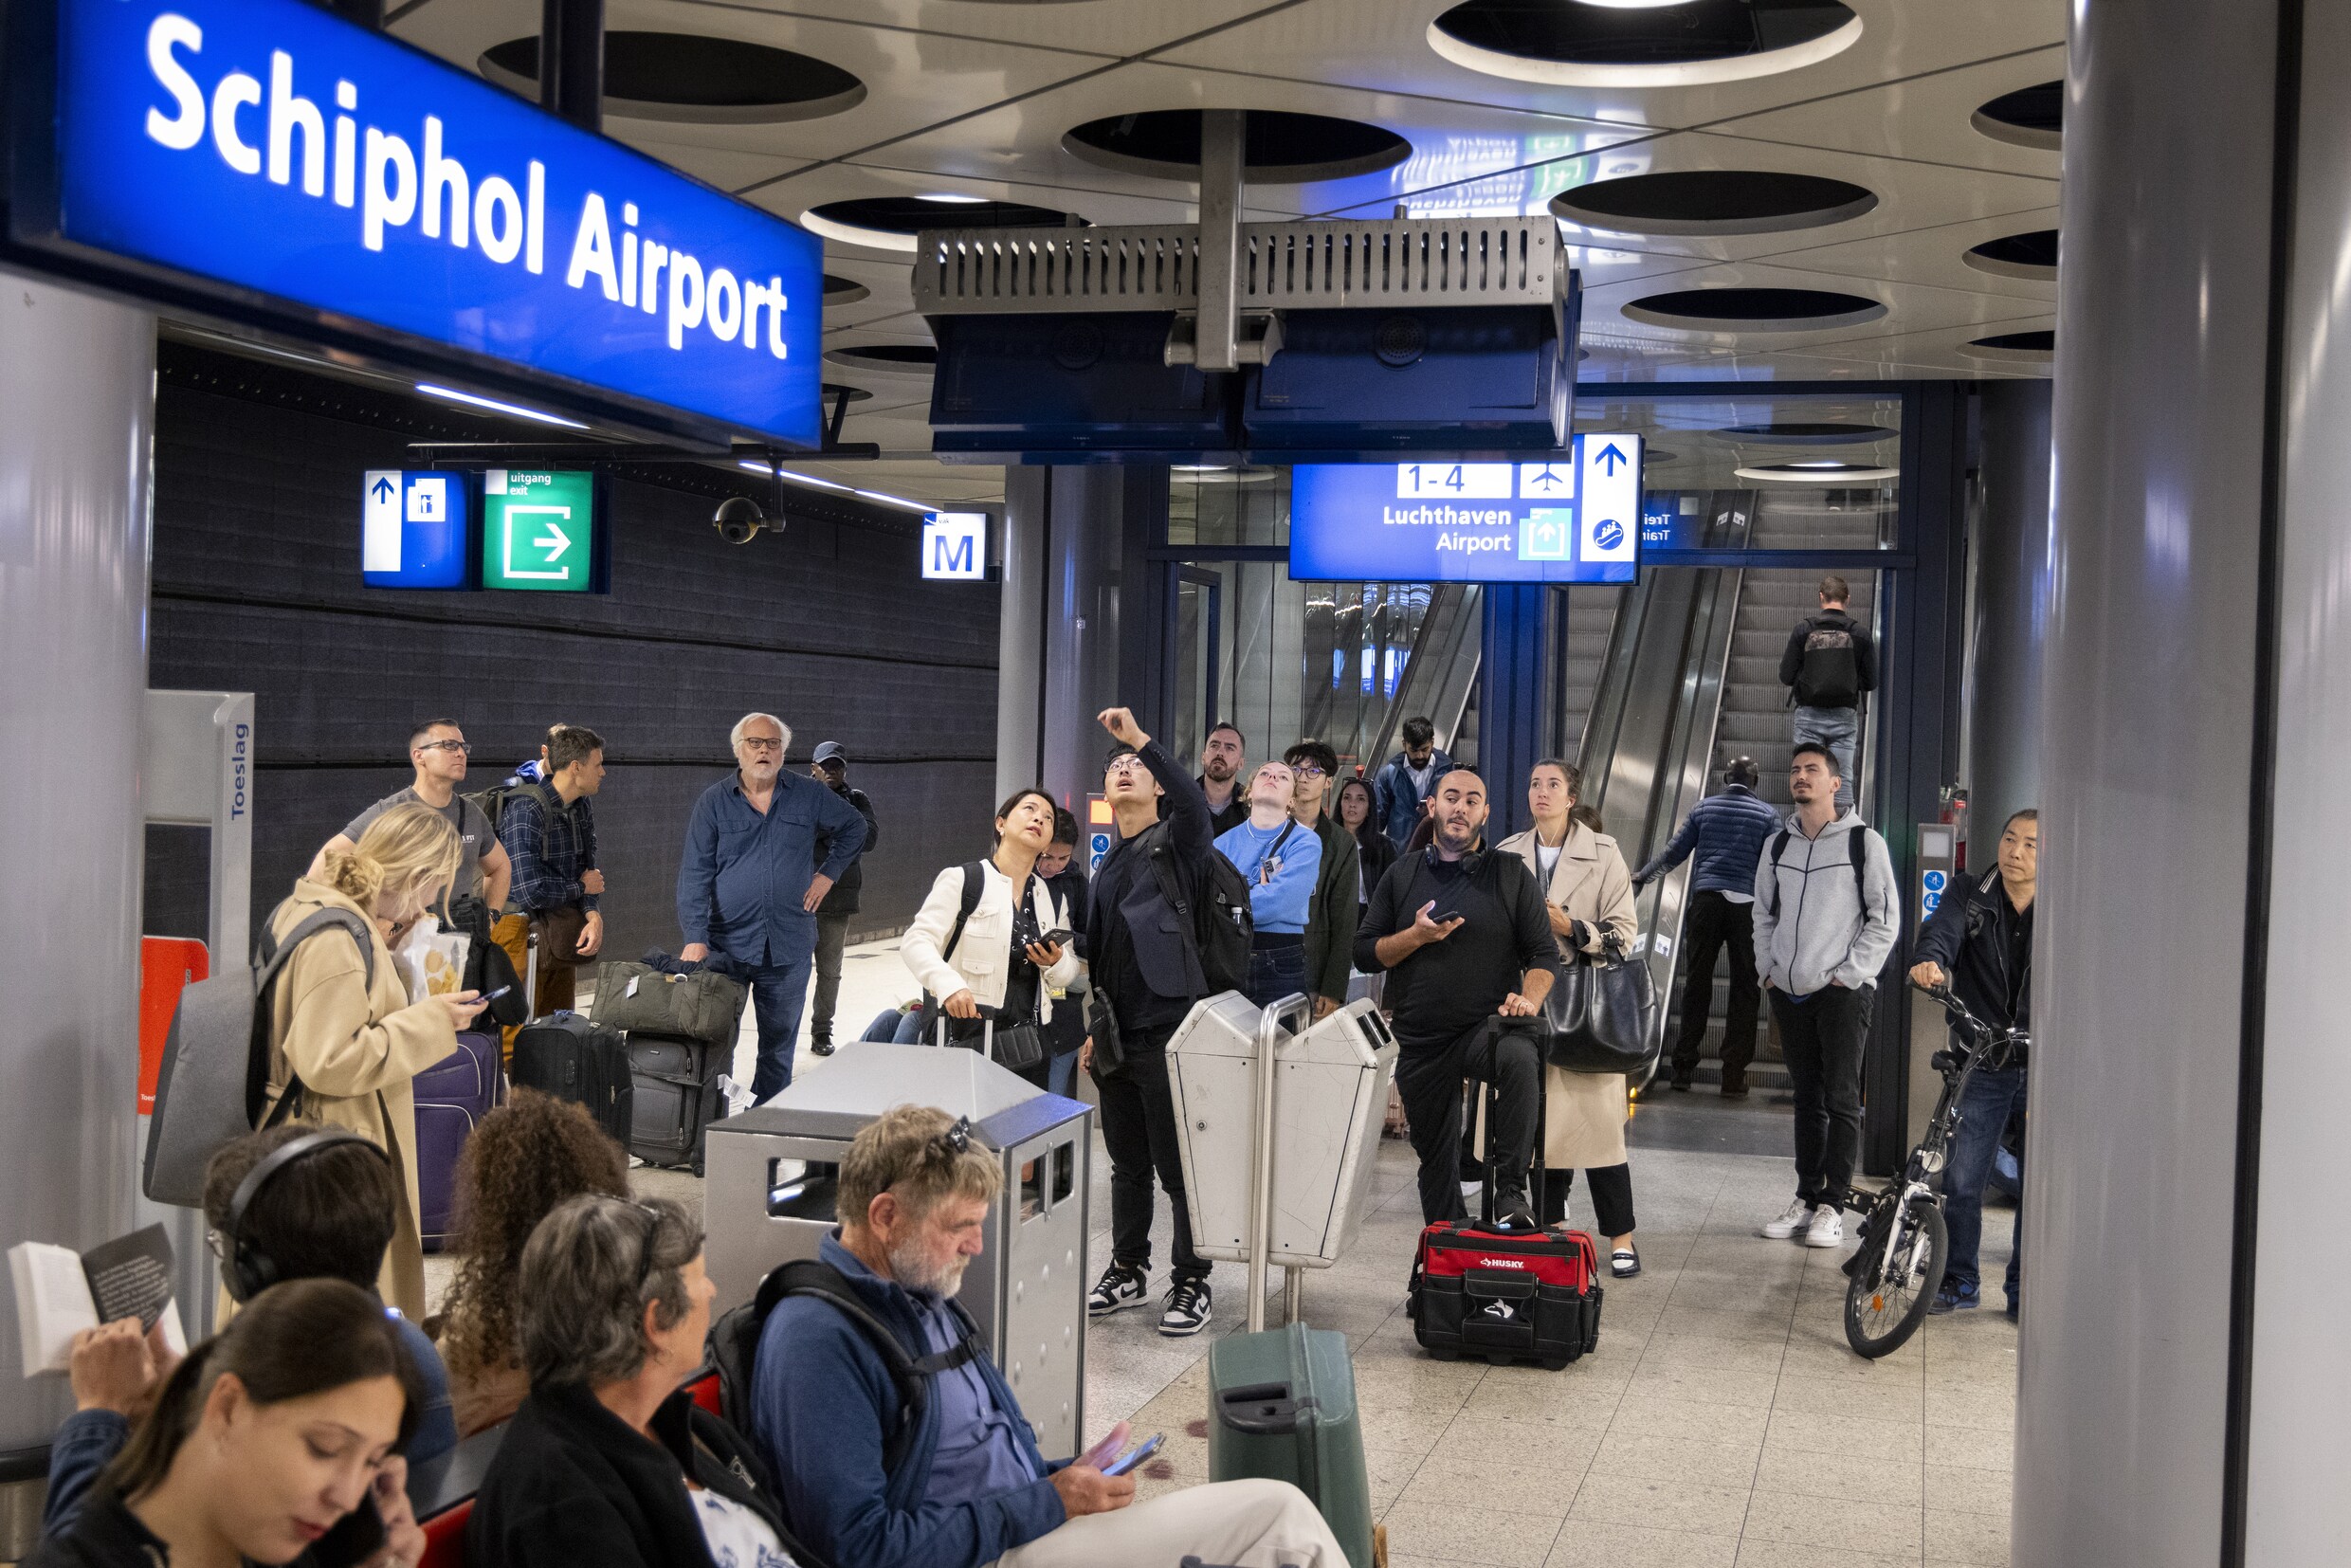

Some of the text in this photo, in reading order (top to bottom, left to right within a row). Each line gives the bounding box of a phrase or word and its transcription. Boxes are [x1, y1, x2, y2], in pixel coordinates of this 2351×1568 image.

[145, 12, 789, 360] Schiphol Airport
[511, 472, 552, 485] uitgang
[510, 485, 528, 495] exit
[1383, 505, 1512, 525] Luchthaven
[935, 536, 974, 572] M
[1435, 532, 1512, 555] Airport
[231, 723, 249, 821] Toeslag
[1491, 1259, 1524, 1268] HUSKY
